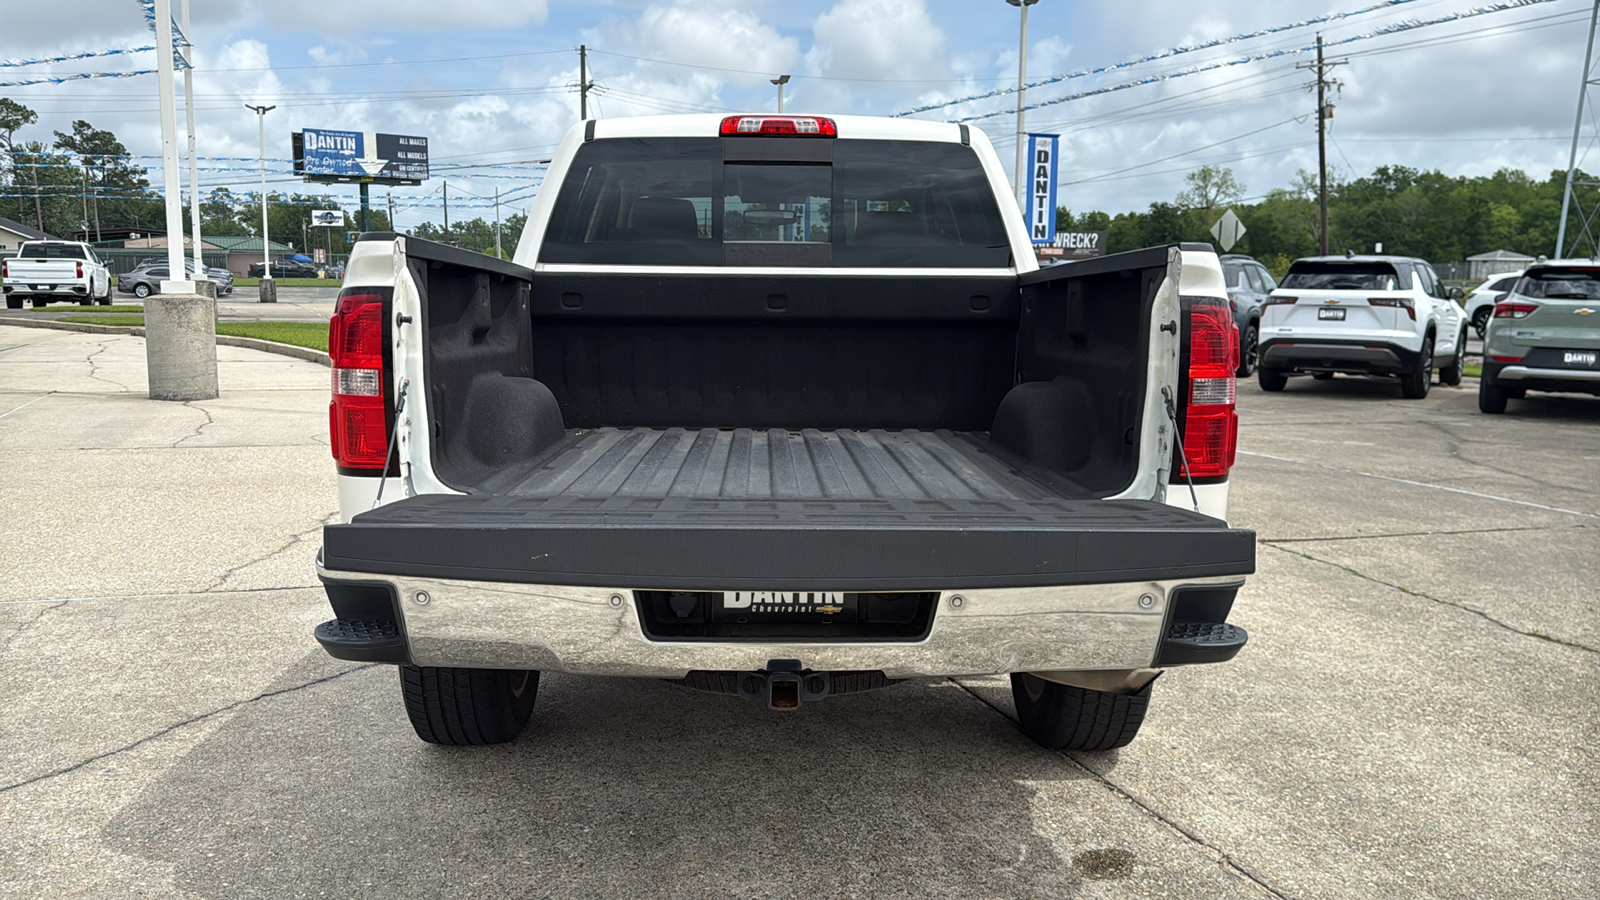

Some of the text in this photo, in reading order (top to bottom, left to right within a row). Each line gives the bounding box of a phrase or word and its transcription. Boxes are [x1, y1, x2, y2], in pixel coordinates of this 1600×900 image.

[304, 132, 356, 150] DANTIN
[399, 137, 426, 146] ALL MAKES
[407, 152, 427, 160] MODELS
[1034, 150, 1049, 238] DANTIN
[1054, 232, 1098, 248] WRECK?
[1320, 310, 1344, 318] DANTIN
[1564, 352, 1596, 363] DANTIN
